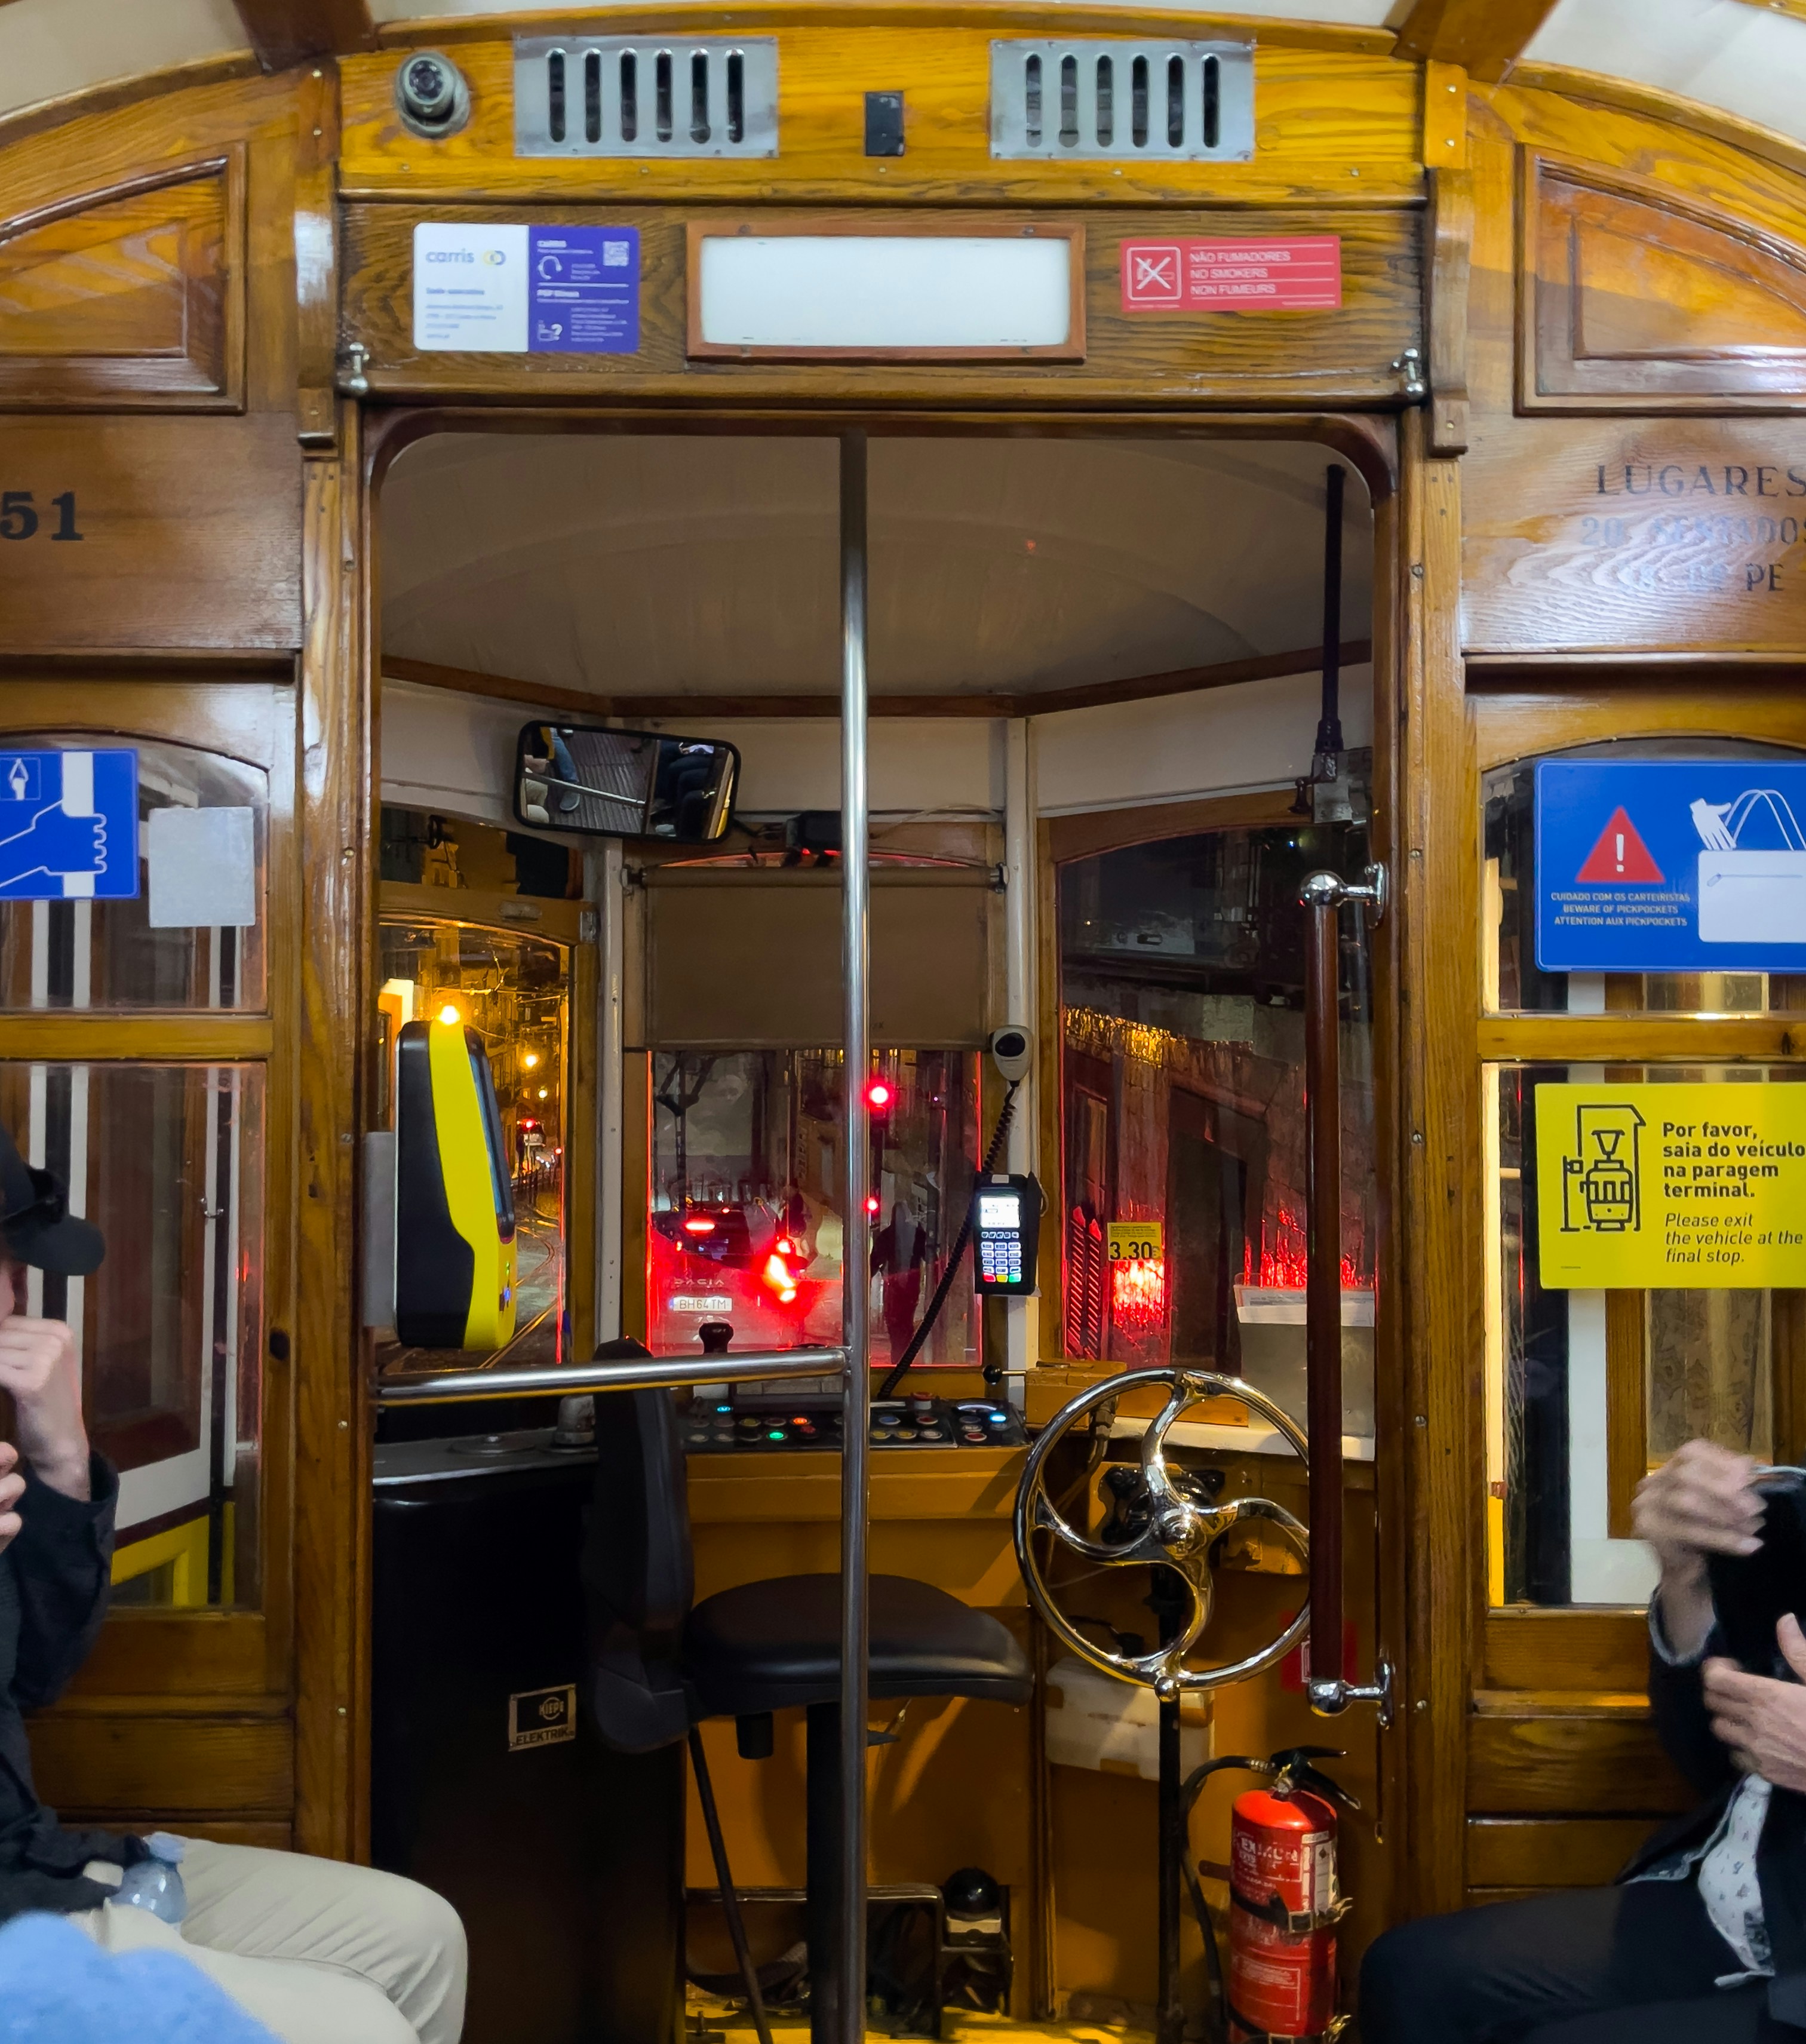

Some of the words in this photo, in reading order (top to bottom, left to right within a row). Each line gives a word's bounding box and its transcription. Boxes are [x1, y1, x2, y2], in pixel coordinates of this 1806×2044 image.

[425, 247, 475, 263] carris
[1217, 251, 1291, 262] FUMADORES
[1190, 269, 1209, 279] NO
[1209, 268, 1268, 278] SMOKERS
[1190, 285, 1217, 295] NON
[1218, 284, 1276, 294] FUMEURS
[1597, 464, 1806, 497] LUGARES
[0, 491, 84, 541] 51
[1551, 892, 1591, 901] CUIDADO
[1592, 892, 1612, 901] COM
[1614, 892, 1626, 901] OS
[1628, 893, 1690, 902] CARTEIRISTAS
[1563, 904, 1601, 913] BEWARE
[1617, 905, 1678, 913] PICKPOCKETS
[1554, 916, 1604, 925] ATTENTION
[1605, 917, 1624, 925] AUX
[1626, 917, 1687, 926] PICKPOCKETS
[1663, 1122, 1697, 1138] Por
[1702, 1121, 1758, 1140] favor,
[1663, 1141, 1701, 1158] saia
[1707, 1141, 1731, 1158] do
[1736, 1139, 1805, 1158] veículo
[1664, 1165, 1686, 1177] na
[1693, 1165, 1779, 1181] paragem
[1664, 1181, 1755, 1198] terminal.
[1666, 1213, 1719, 1227] Please
[1724, 1212, 1752, 1227] exit
[1666, 1230, 1691, 1245] the
[1696, 1230, 1752, 1245] vehicle
[1758, 1231, 1772, 1245] at
[1777, 1230, 1803, 1245] the
[1666, 1248, 1701, 1263] final
[1706, 1248, 1744, 1266] stop.
